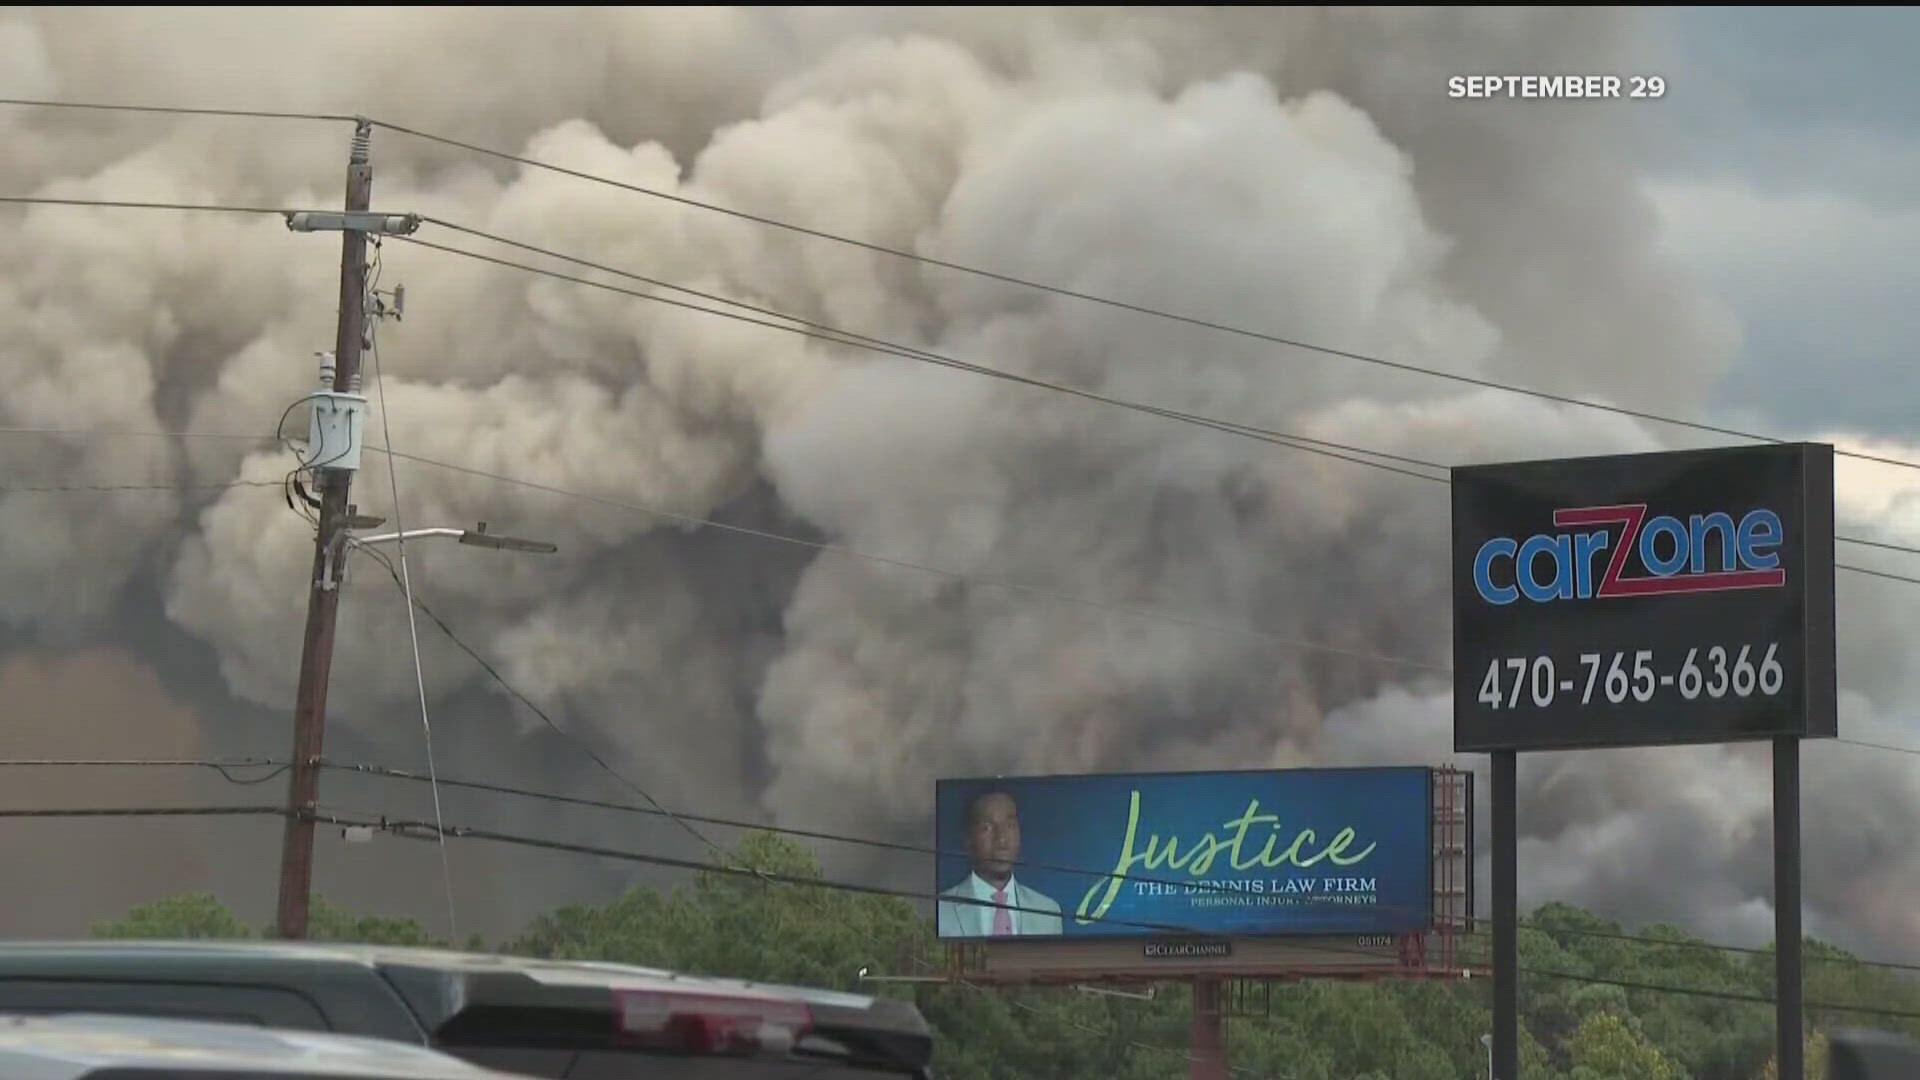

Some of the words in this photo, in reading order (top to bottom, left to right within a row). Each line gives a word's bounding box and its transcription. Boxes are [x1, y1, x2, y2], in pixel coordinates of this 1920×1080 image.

[1478, 643, 1784, 710] 470-765-6366
[1075, 790, 1377, 925] Justice
[1134, 881, 1177, 895] THE
[1184, 880, 1264, 894] DENNIS
[1271, 879, 1317, 893] LAW
[1323, 878, 1377, 892] FIRM
[1191, 897, 1253, 907] PERSONAL
